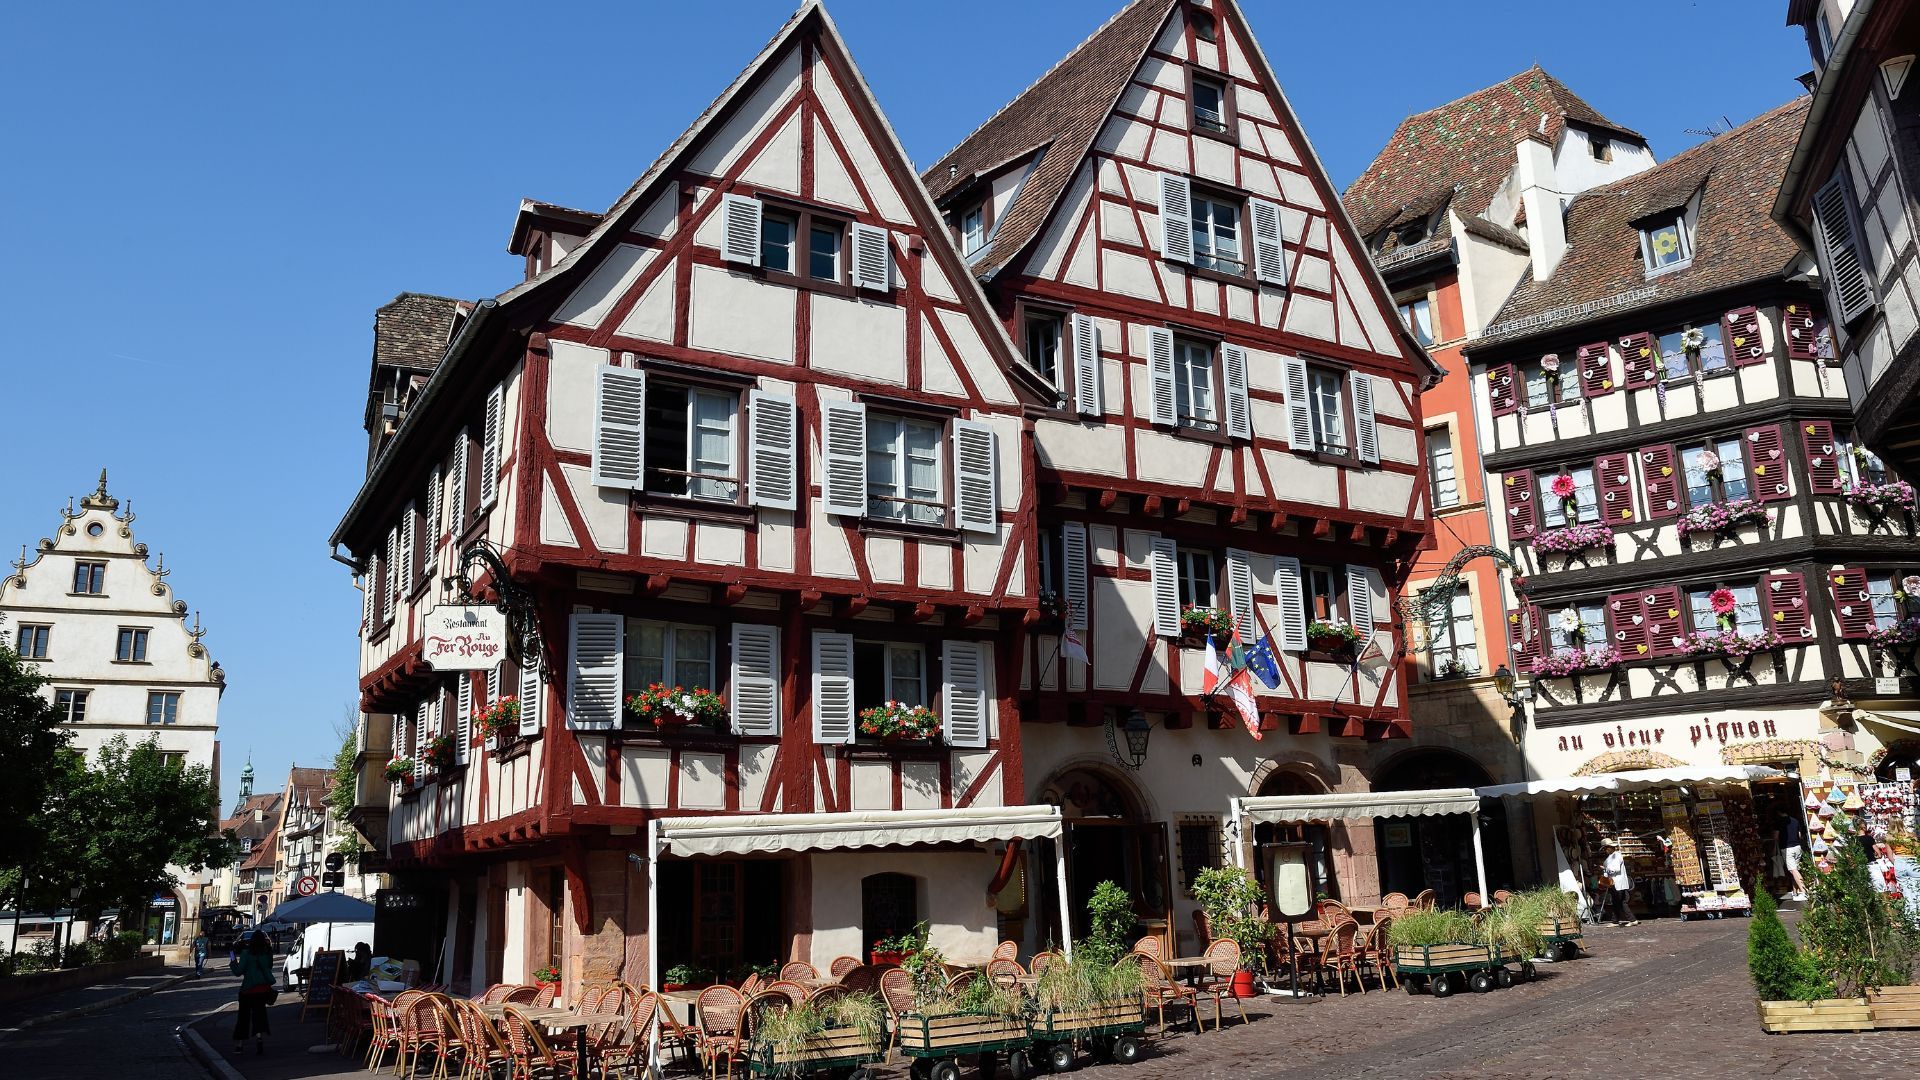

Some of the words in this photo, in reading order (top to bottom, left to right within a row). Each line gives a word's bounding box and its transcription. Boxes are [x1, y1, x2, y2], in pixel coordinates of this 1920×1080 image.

[443, 618, 487, 629] Restaurant
[476, 632, 491, 641] Au
[427, 635, 456, 660] Fer
[455, 634, 499, 658] Rouge
[1558, 735, 1584, 751] au
[1690, 717, 1778, 747] pignon
